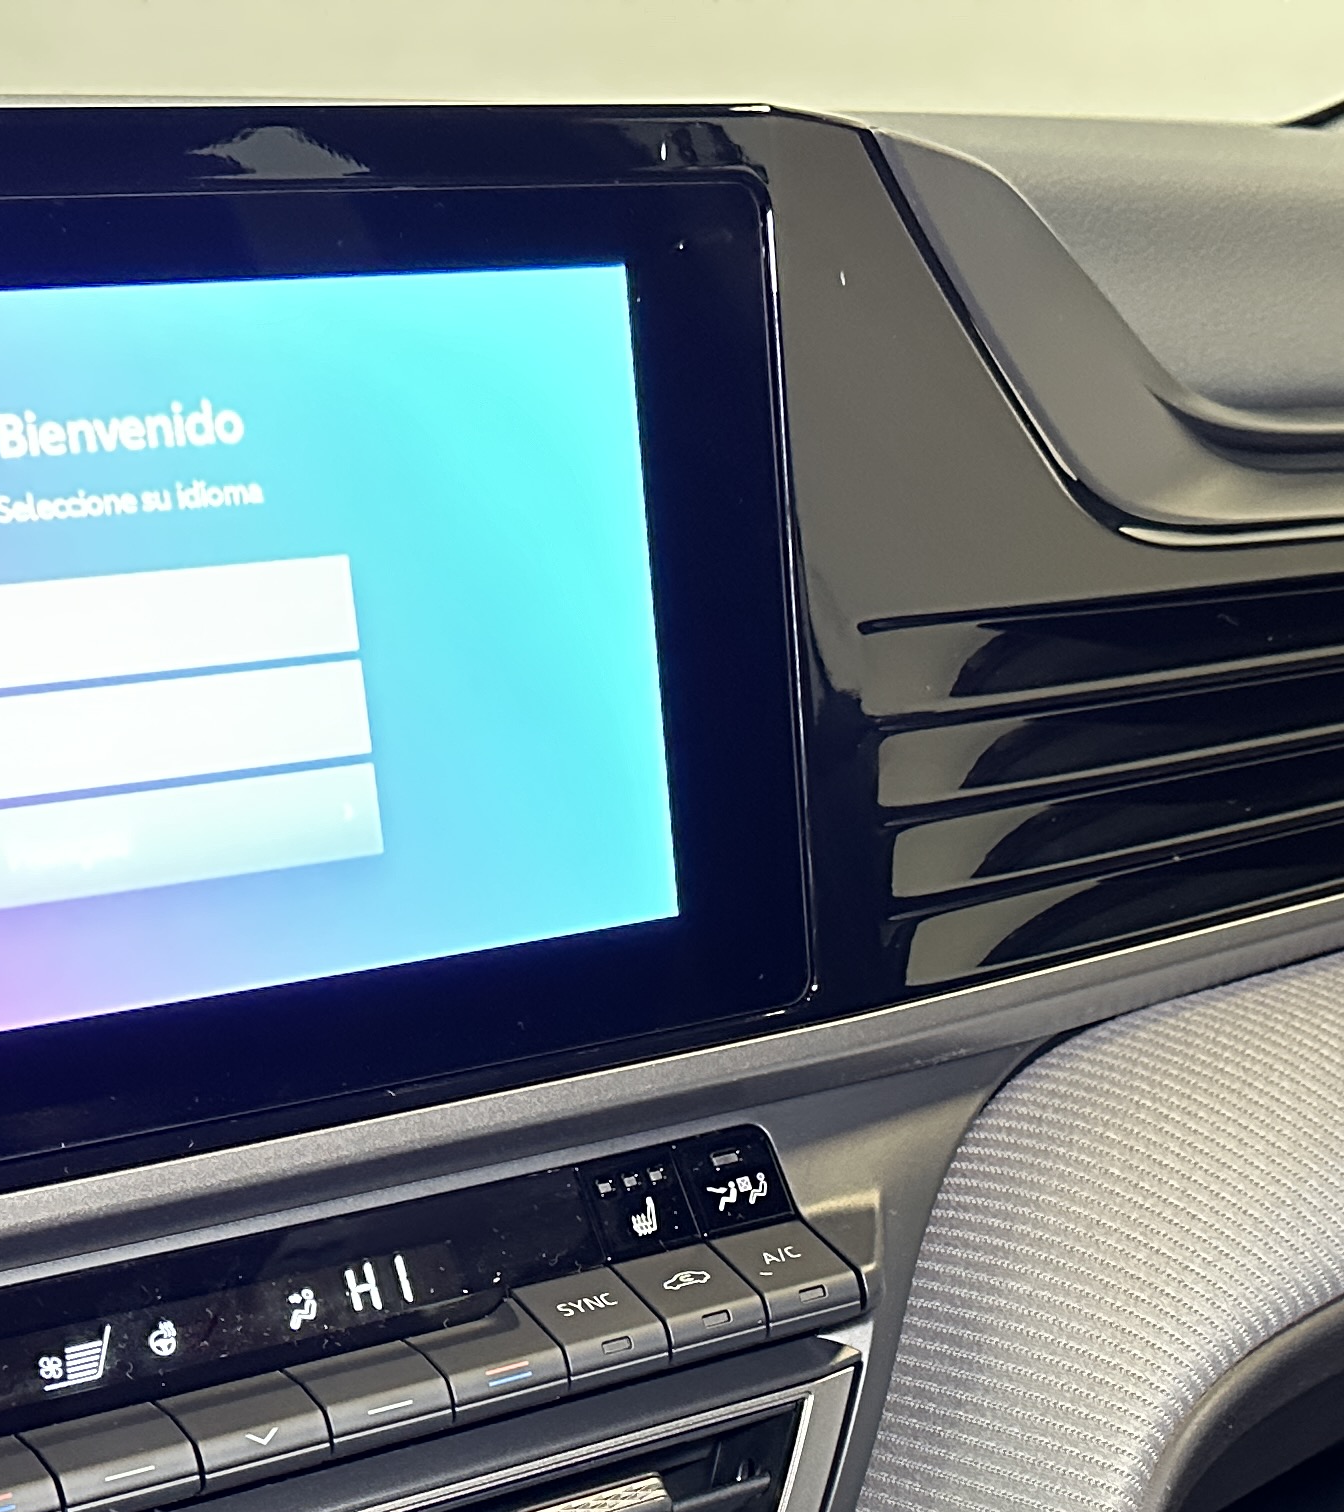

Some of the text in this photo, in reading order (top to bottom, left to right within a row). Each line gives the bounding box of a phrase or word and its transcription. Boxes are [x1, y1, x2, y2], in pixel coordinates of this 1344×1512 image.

[141, 489, 173, 512] su
[175, 479, 265, 510] idioma
[762, 1244, 803, 1266] A/C
[344, 1252, 414, 1312] HI
[556, 1291, 619, 1318] SYNC
